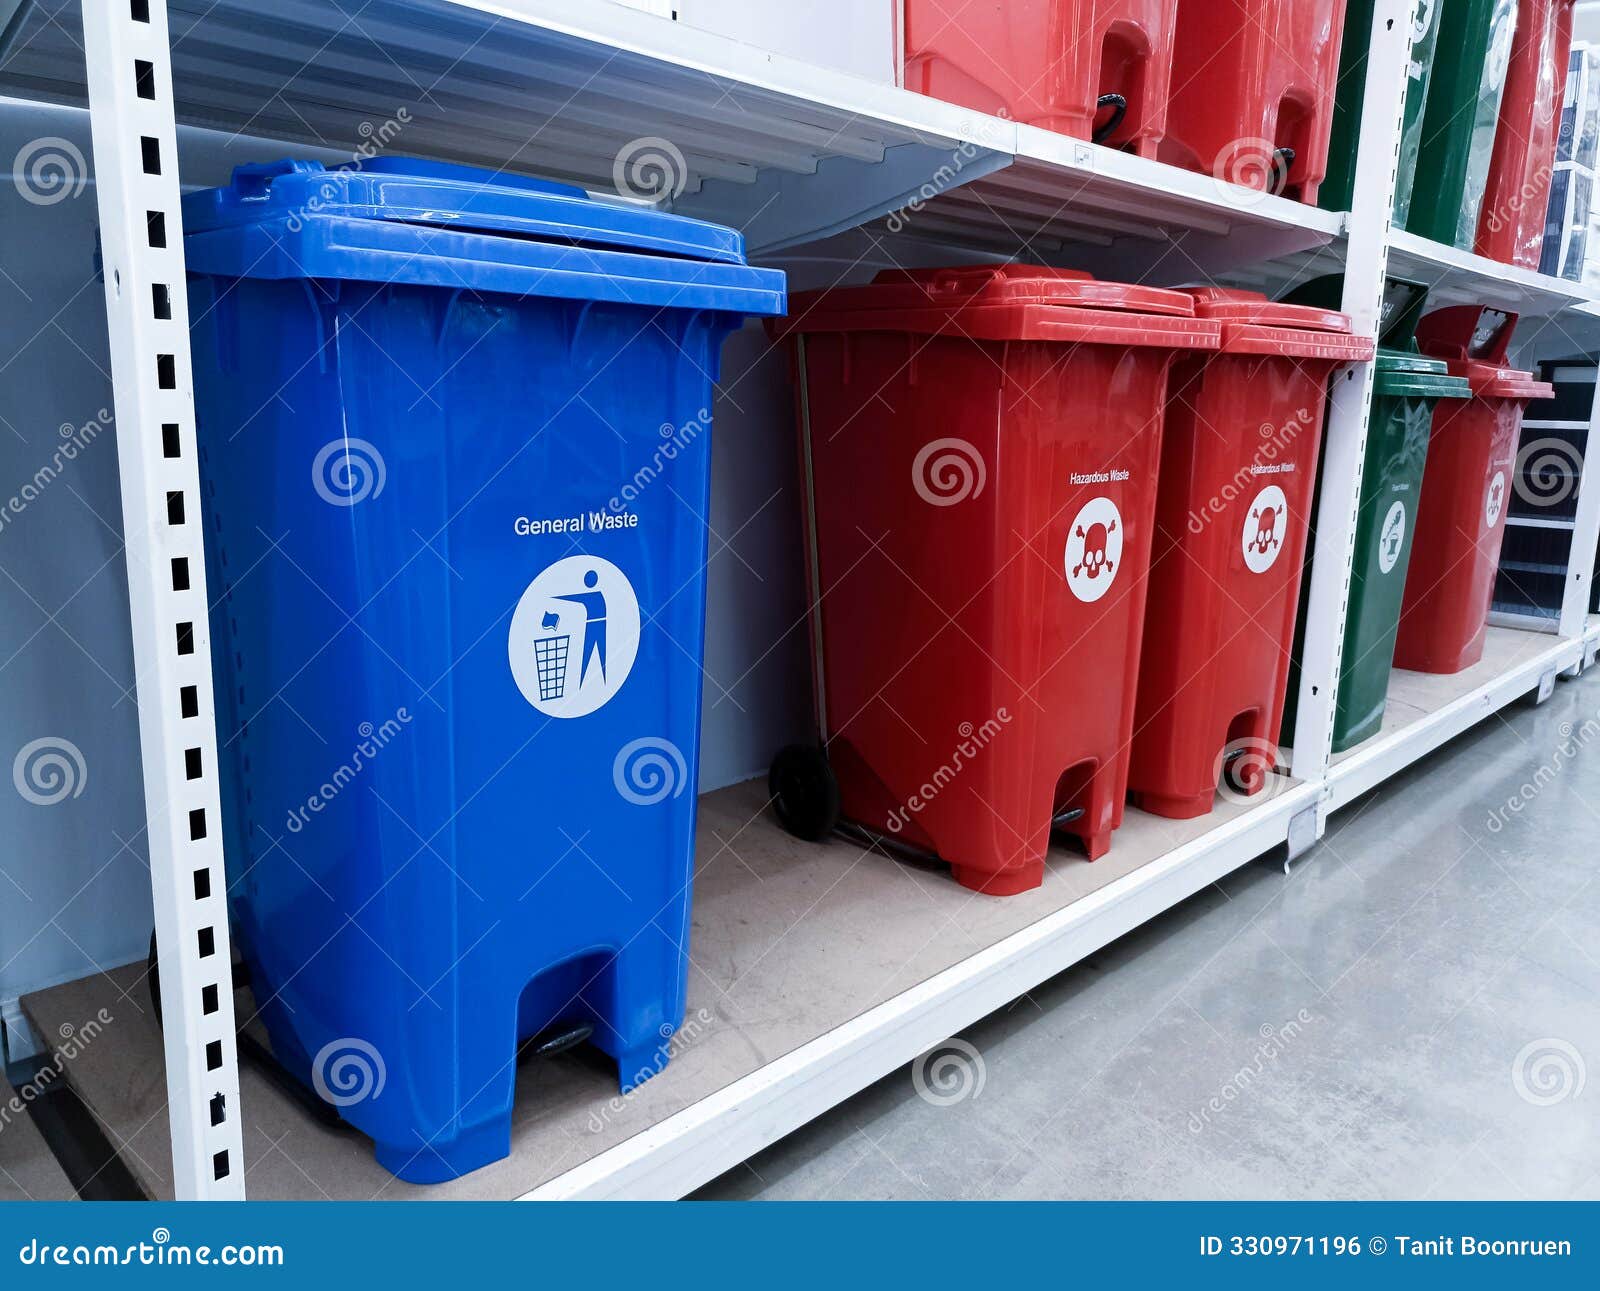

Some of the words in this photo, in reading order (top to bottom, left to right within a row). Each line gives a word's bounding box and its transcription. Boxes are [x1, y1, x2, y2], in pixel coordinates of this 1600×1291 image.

[1070, 471, 1109, 485] Hazardous
[1110, 468, 1130, 481] Waste
[514, 513, 584, 536] General
[589, 511, 638, 531] Waste
